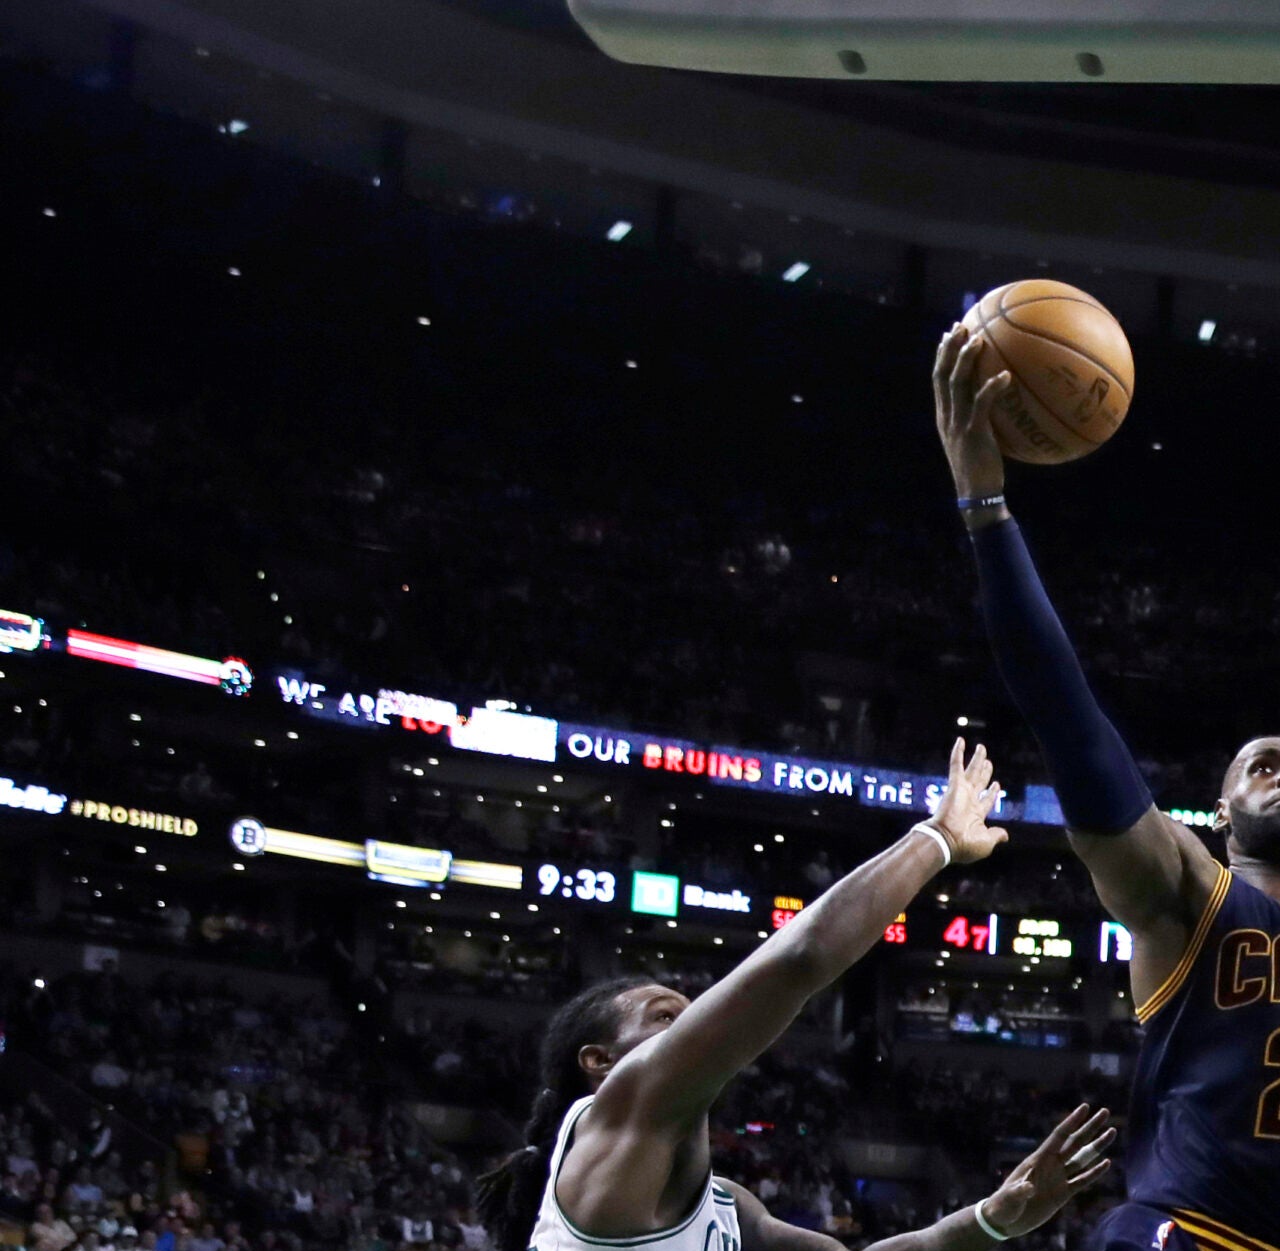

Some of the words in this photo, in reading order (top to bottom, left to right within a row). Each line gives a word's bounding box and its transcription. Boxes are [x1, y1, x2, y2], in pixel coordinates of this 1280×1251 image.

[567, 732, 631, 765] OUR
[642, 743, 762, 783] BRUINS
[773, 761, 852, 797] FROM
[69, 799, 199, 837] #PROSHIELD
[537, 863, 616, 902] 9:33
[683, 884, 751, 913] Bank
